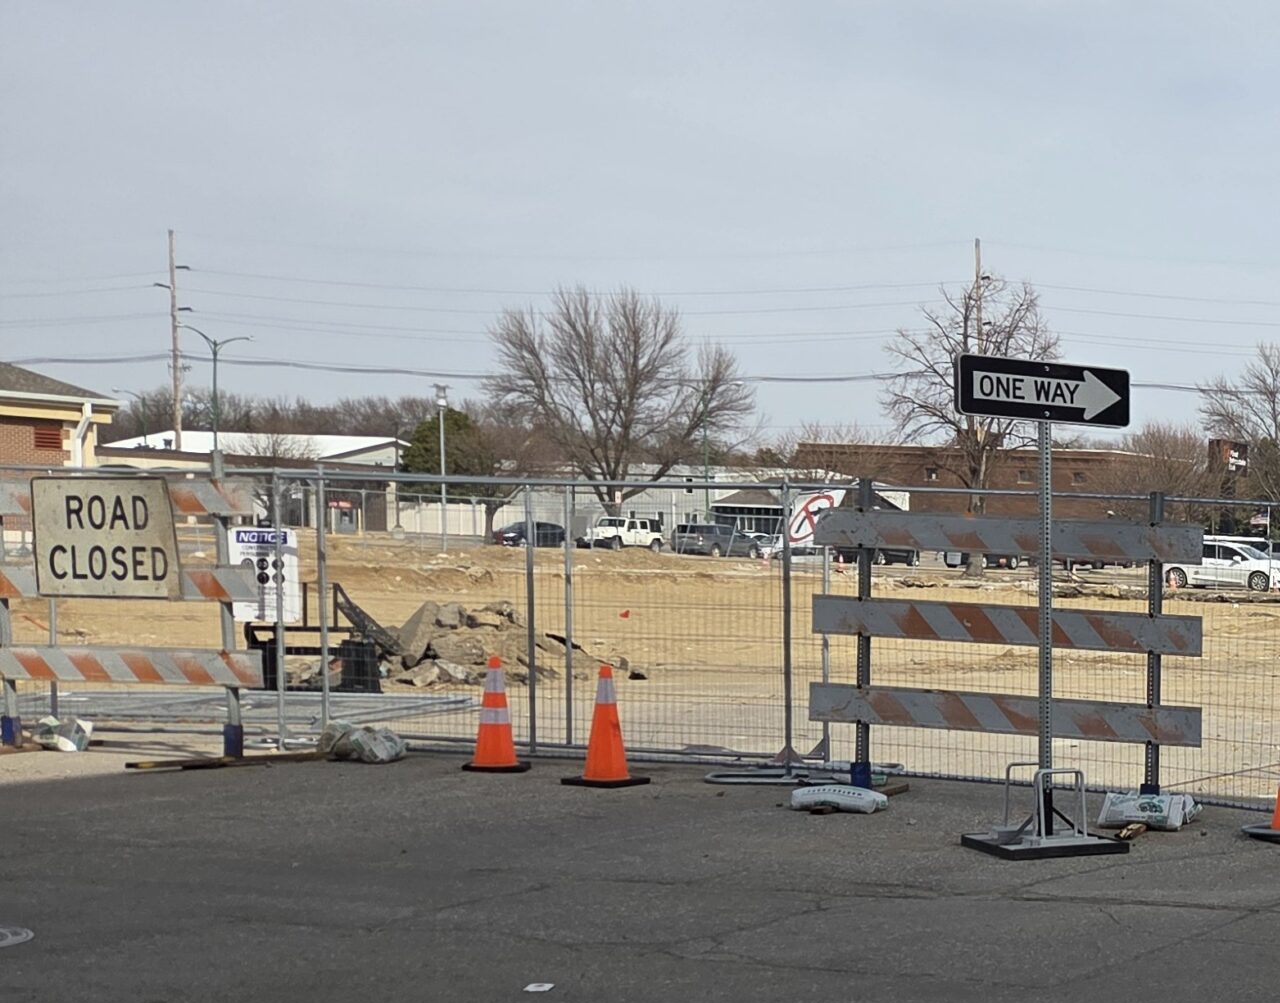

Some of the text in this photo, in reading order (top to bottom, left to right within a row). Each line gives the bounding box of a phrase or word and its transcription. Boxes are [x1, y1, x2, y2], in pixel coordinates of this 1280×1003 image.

[980, 375, 1080, 405] ONE WAY
[65, 494, 148, 530] ROAD
[49, 544, 168, 581] CLOSED
